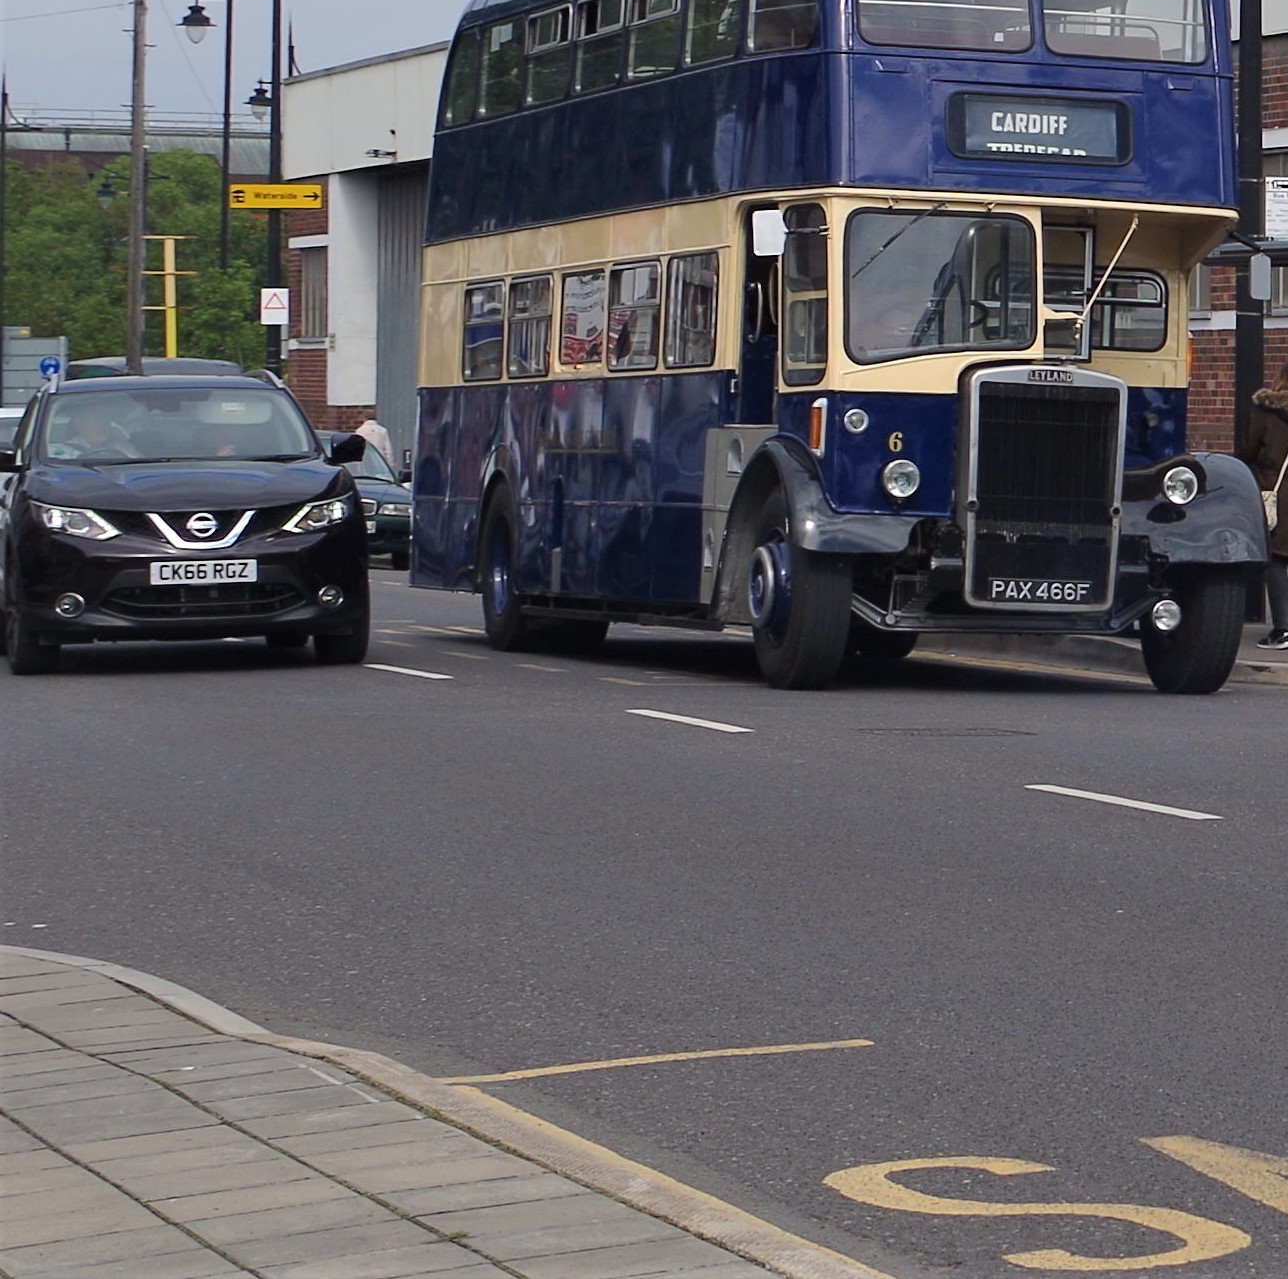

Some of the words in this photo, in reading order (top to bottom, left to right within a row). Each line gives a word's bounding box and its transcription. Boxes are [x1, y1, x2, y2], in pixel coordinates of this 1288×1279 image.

[991, 111, 1068, 135] CARDIFF
[254, 192, 297, 200] Waterside
[1030, 370, 1073, 381] LEYLAND
[889, 431, 903, 452] 6
[160, 563, 207, 580] CK66
[213, 562, 249, 579] RGZ
[992, 580, 1033, 600] PAX
[1036, 582, 1090, 601] 466F
